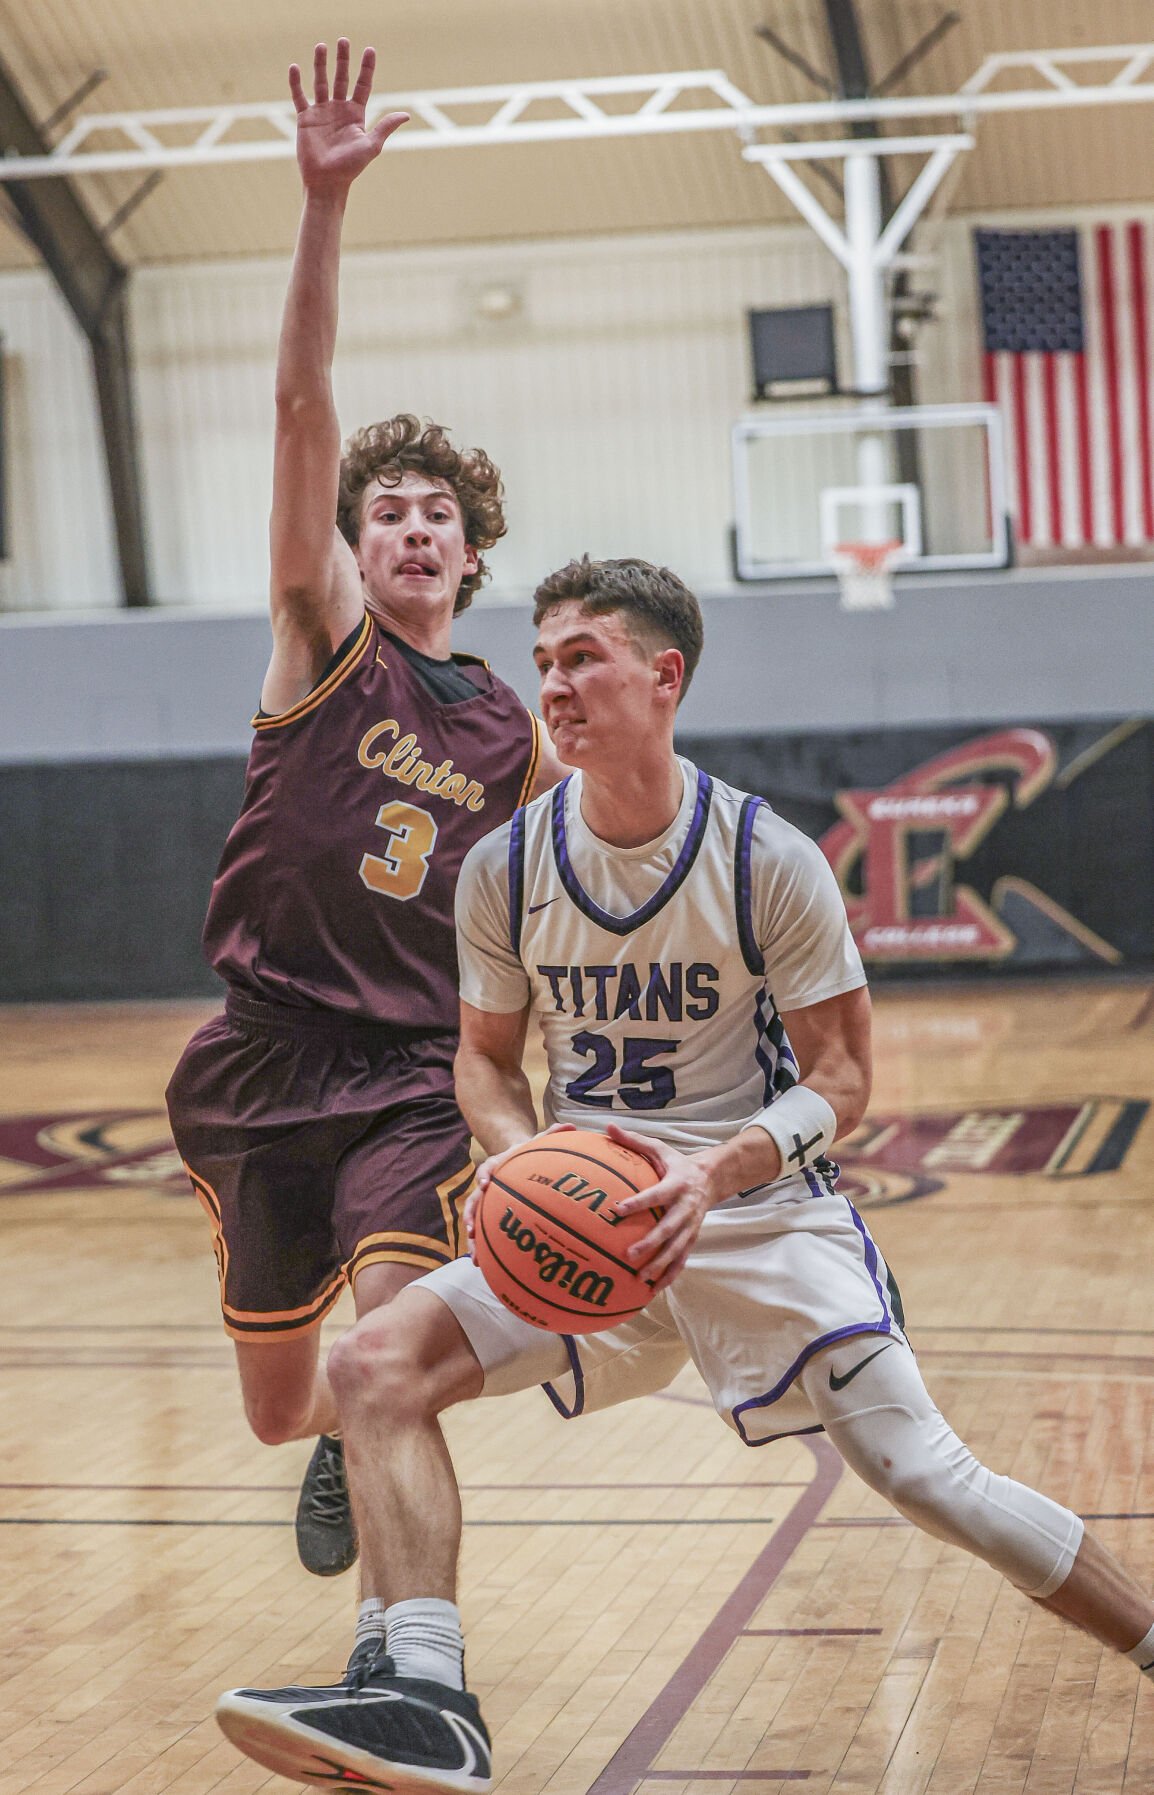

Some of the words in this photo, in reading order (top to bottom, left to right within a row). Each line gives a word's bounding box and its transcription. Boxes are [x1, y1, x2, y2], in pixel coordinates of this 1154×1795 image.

[358, 719, 485, 812] Clinton
[358, 800, 438, 901] 3
[536, 962, 720, 1021] TITANS
[565, 1030, 682, 1110] 25
[498, 1207, 614, 1306] Wilson
